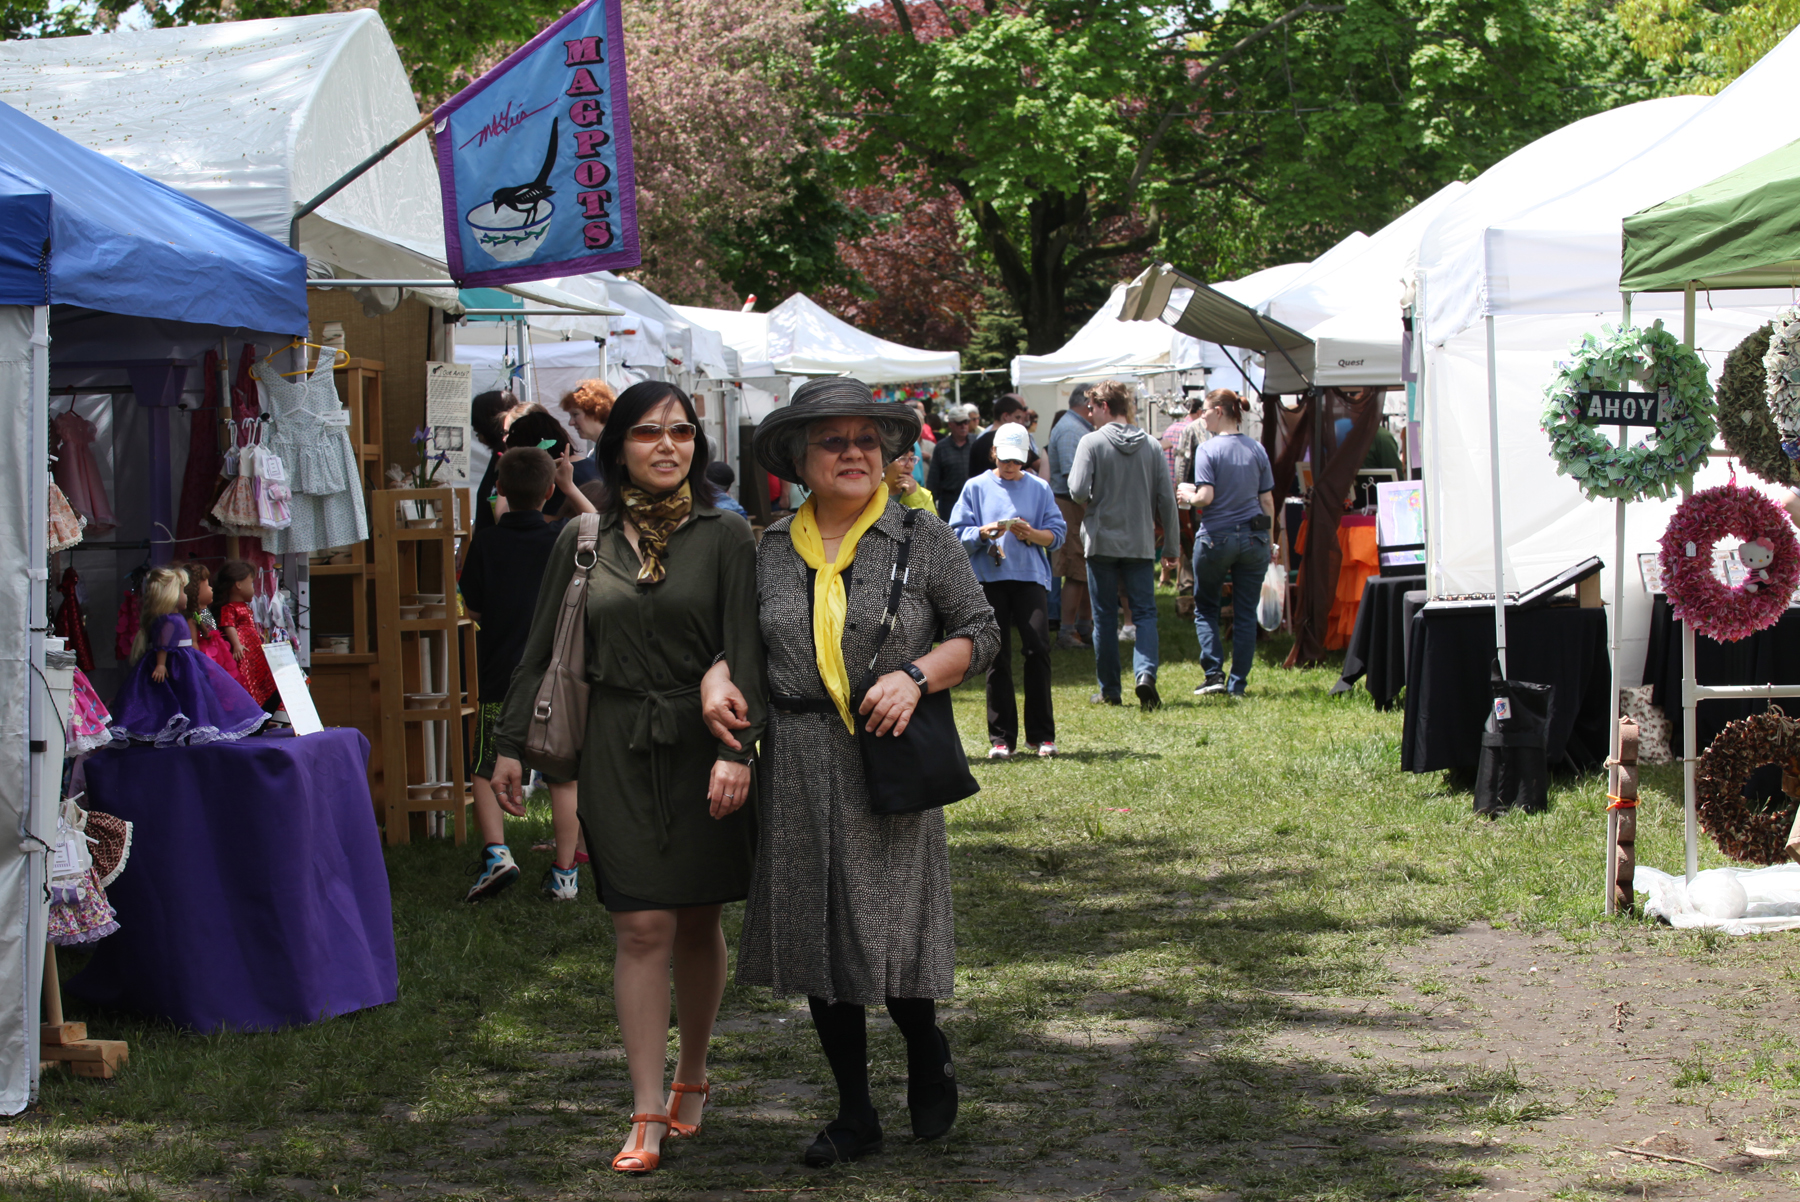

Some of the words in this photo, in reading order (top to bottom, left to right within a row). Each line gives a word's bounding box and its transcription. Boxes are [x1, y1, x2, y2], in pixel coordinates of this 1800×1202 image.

[564, 36, 614, 250] MAGPOTS
[1338, 358, 1365, 368] Quest
[1587, 395, 1655, 420] AHOY
